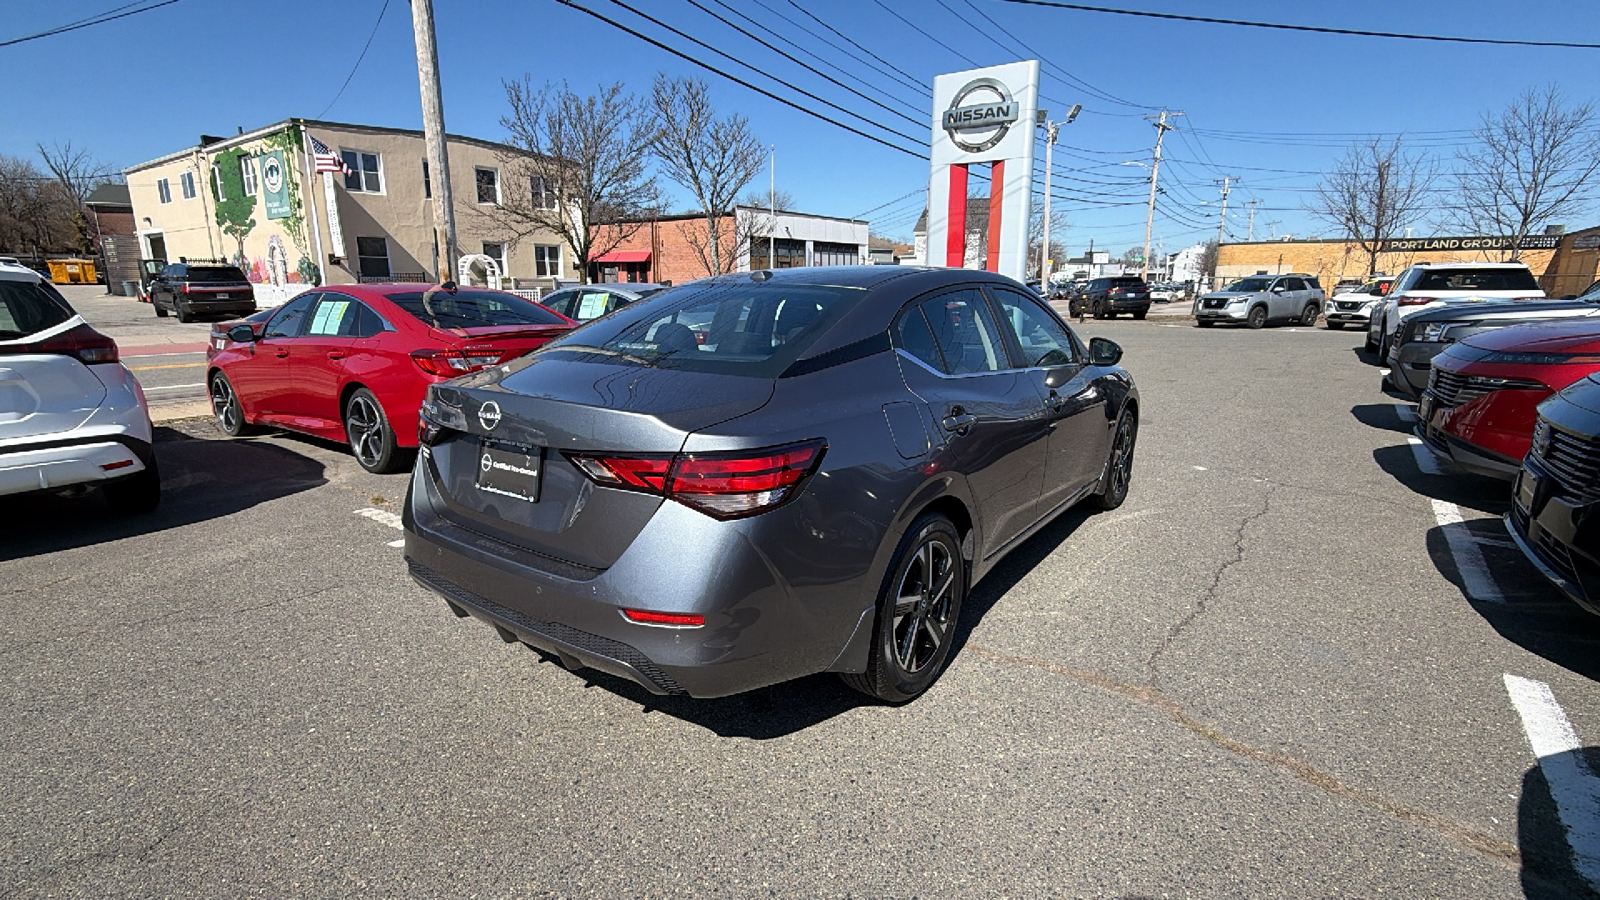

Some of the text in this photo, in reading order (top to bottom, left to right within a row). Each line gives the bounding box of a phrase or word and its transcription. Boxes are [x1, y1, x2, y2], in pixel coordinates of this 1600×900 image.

[948, 105, 1010, 123] NISSAN
[1391, 239, 1459, 249] PORTLAND
[493, 461, 537, 476] Certified Pre-Owned
